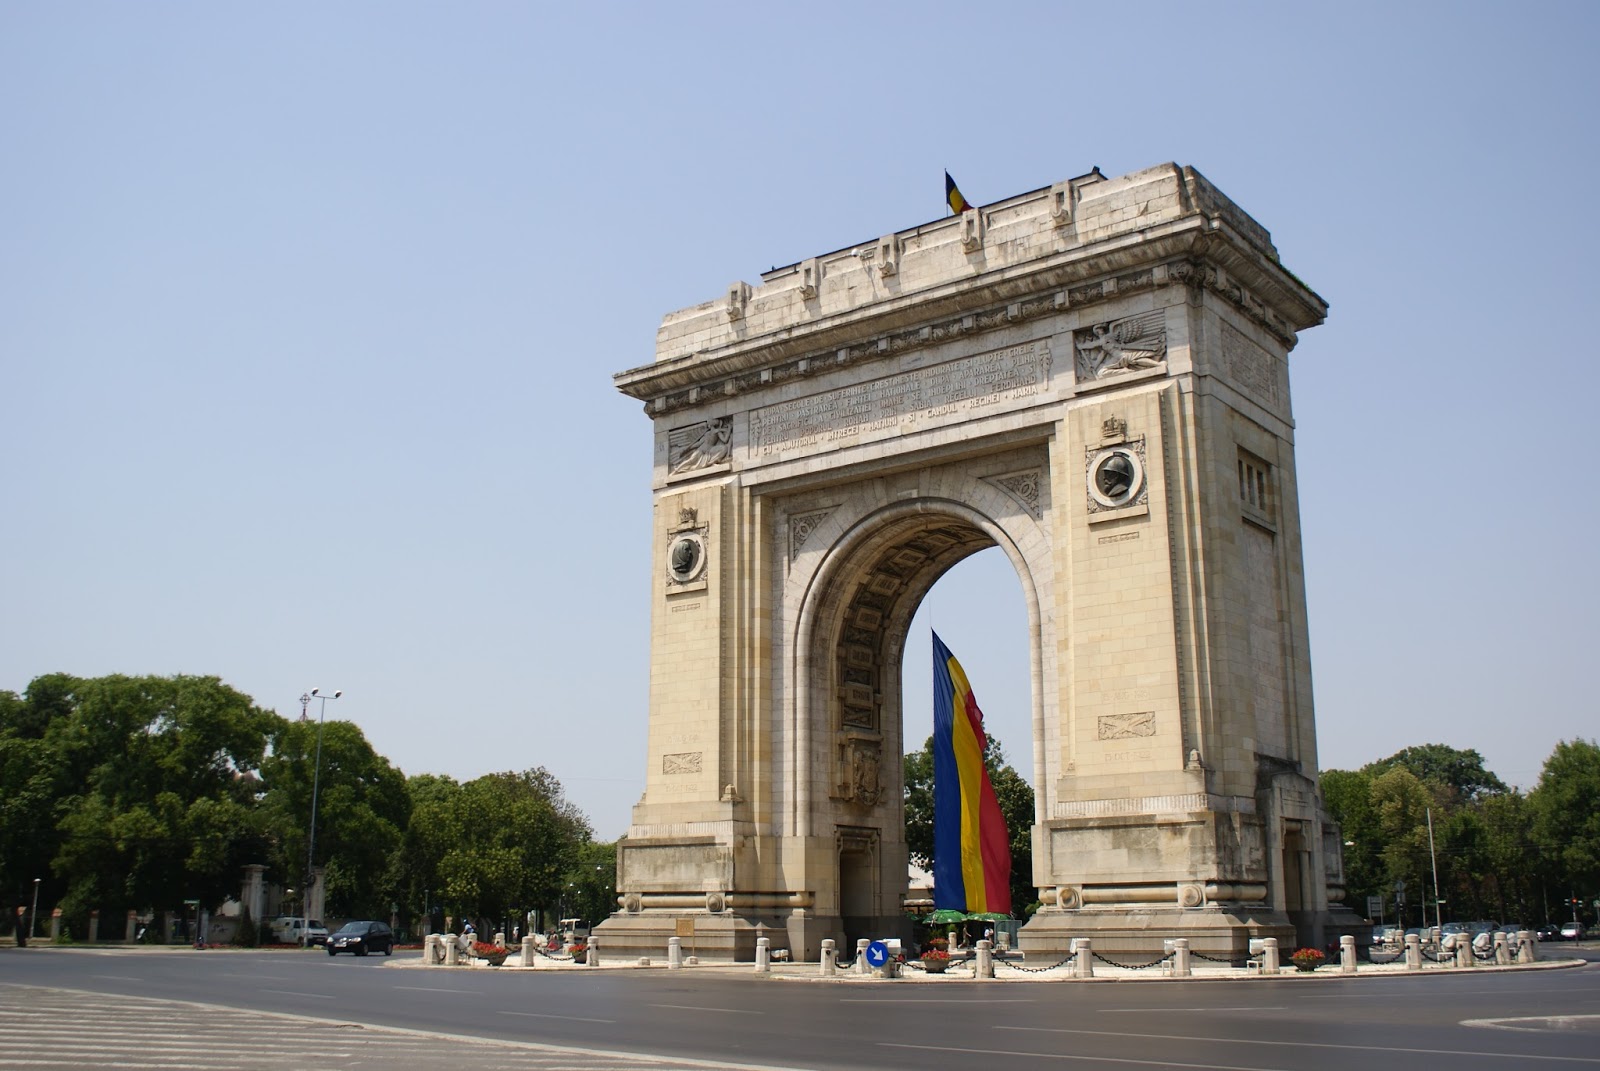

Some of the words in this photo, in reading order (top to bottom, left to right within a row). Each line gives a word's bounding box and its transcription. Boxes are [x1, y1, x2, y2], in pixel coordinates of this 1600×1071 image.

[814, 394, 823, 404] DE
[977, 350, 1003, 365] LUPTE
[1008, 343, 1034, 357] GRELE
[762, 431, 788, 445] PENTRU
[800, 421, 832, 436] POPORUL
[880, 406, 897, 418] PRIN
[910, 398, 931, 411] SABIA
[944, 387, 977, 403] REGELUI
[991, 373, 1035, 392] FERDINAND
[762, 425, 771, 435] DE
[818, 413, 823, 422] A
[911, 390, 920, 401] SE
[762, 412, 788, 426] PENTRU
[762, 444, 772, 455] CU
[781, 434, 816, 450] AJUTORUL
[1011, 383, 1038, 398] MARIA
